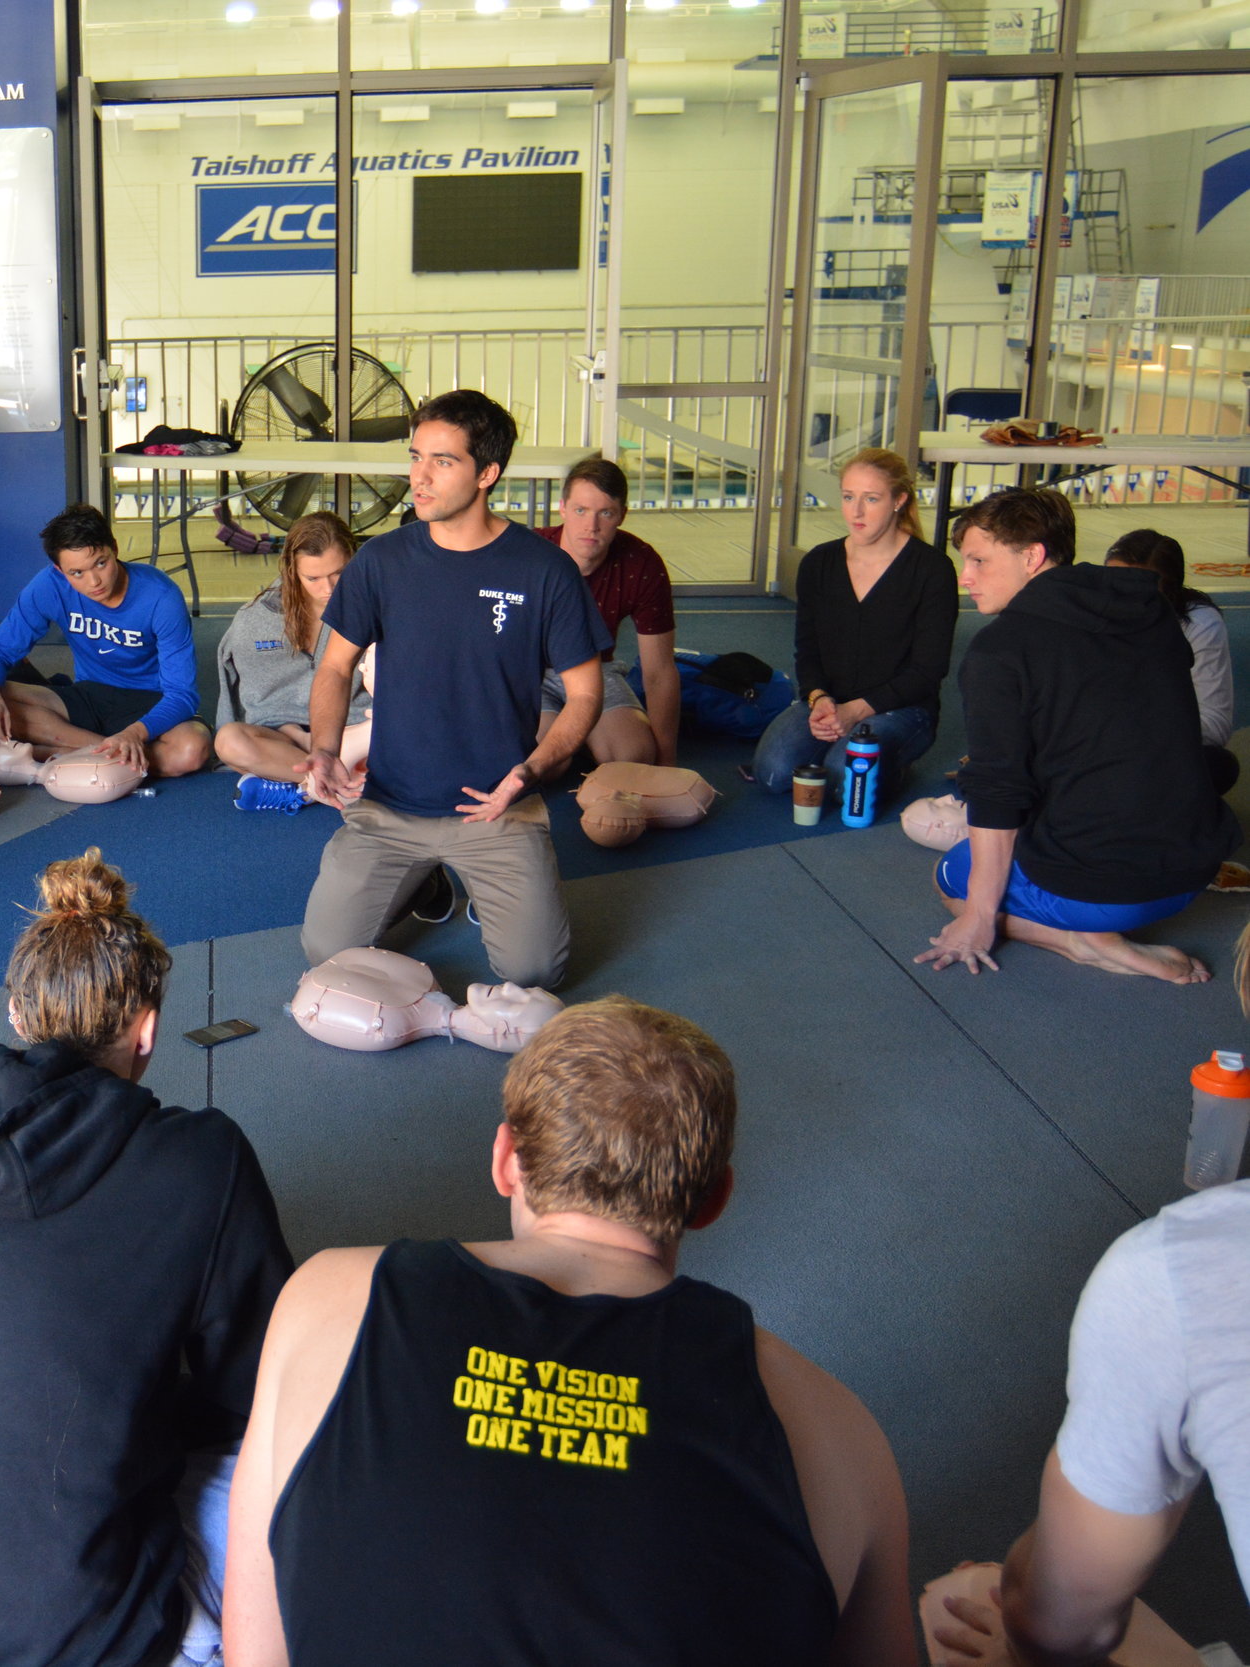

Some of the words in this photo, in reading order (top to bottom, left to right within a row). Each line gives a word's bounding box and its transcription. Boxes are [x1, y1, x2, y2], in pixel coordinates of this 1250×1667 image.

[191, 153, 316, 177] Taishoff
[461, 146, 580, 169] Pavilion
[215, 204, 337, 242] ACC
[479, 589, 504, 600] DUKE
[505, 592, 525, 602] EMS
[69, 612, 143, 647] DUKE
[467, 1346, 529, 1386] ONE
[535, 1361, 640, 1404] VISION
[453, 1376, 517, 1416] ONE
[520, 1388, 649, 1436] MISSION
[466, 1413, 532, 1454] ONE
[538, 1424, 629, 1470] TEAM
